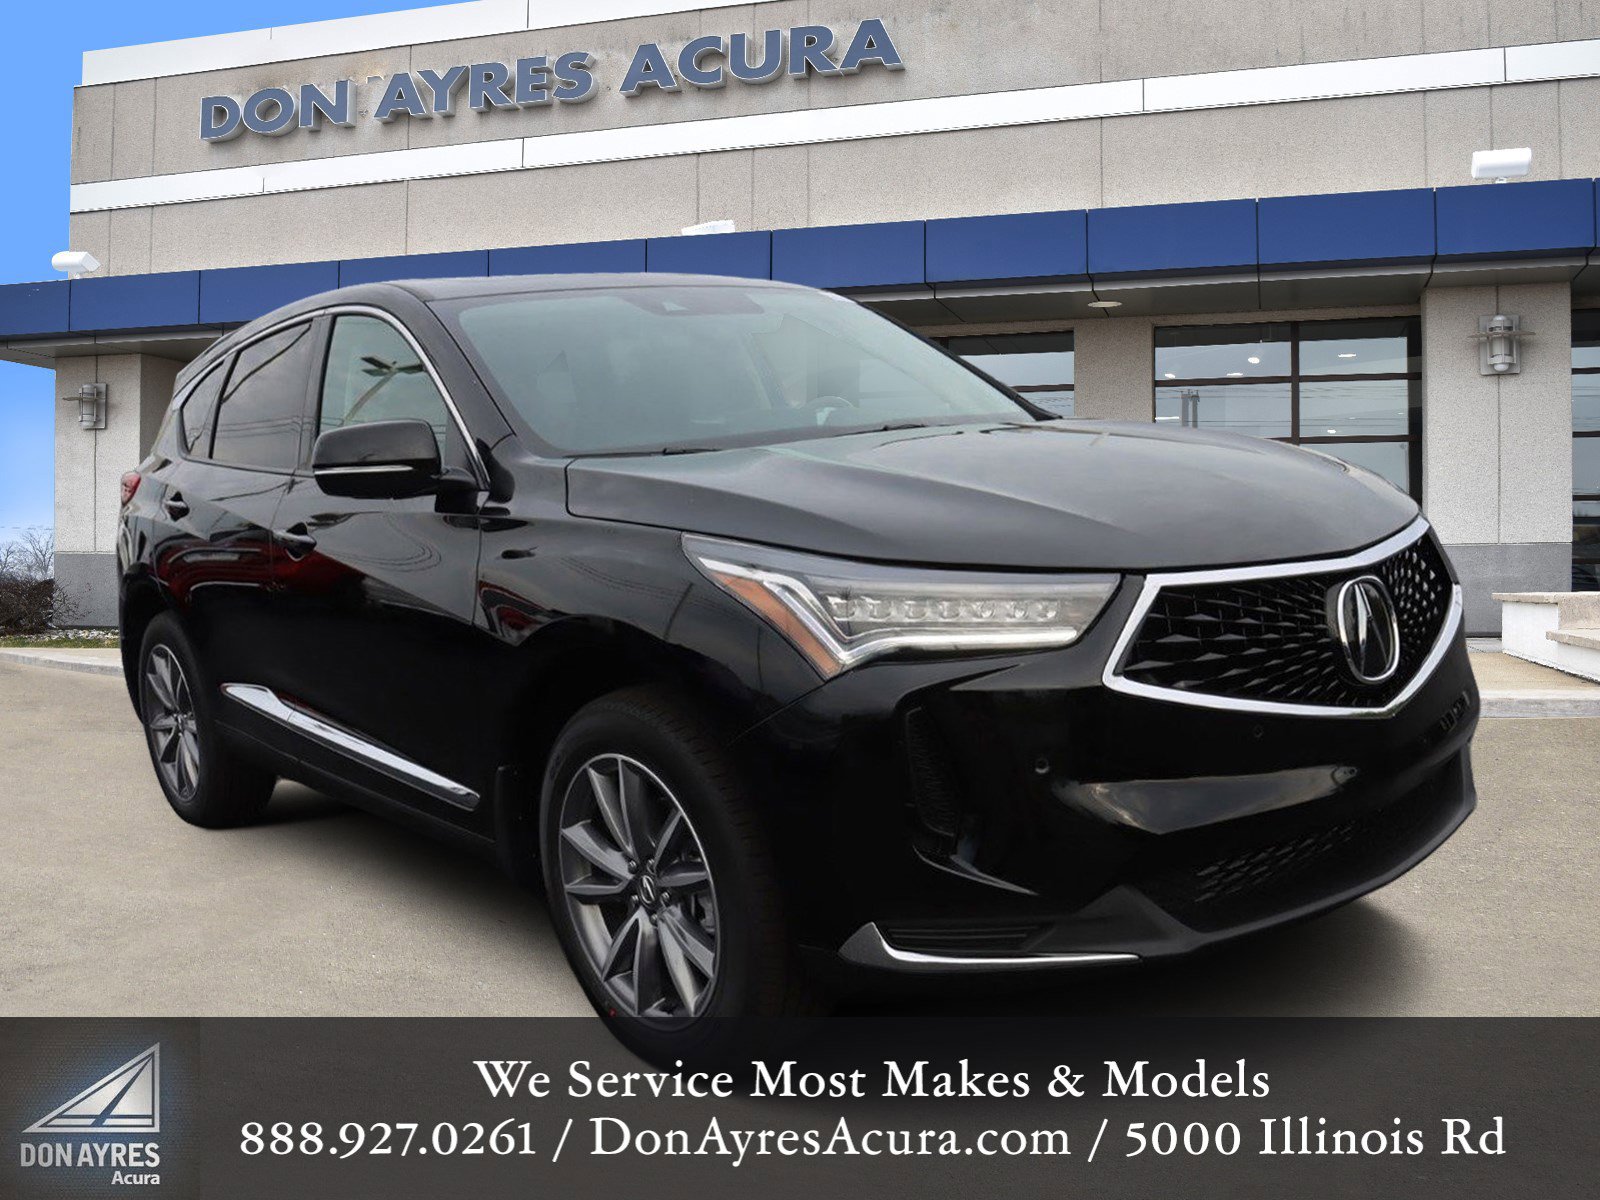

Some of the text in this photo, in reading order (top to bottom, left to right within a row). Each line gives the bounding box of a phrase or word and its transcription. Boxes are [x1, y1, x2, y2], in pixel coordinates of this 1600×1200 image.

[199, 18, 905, 142] DON AYRES ACURA
